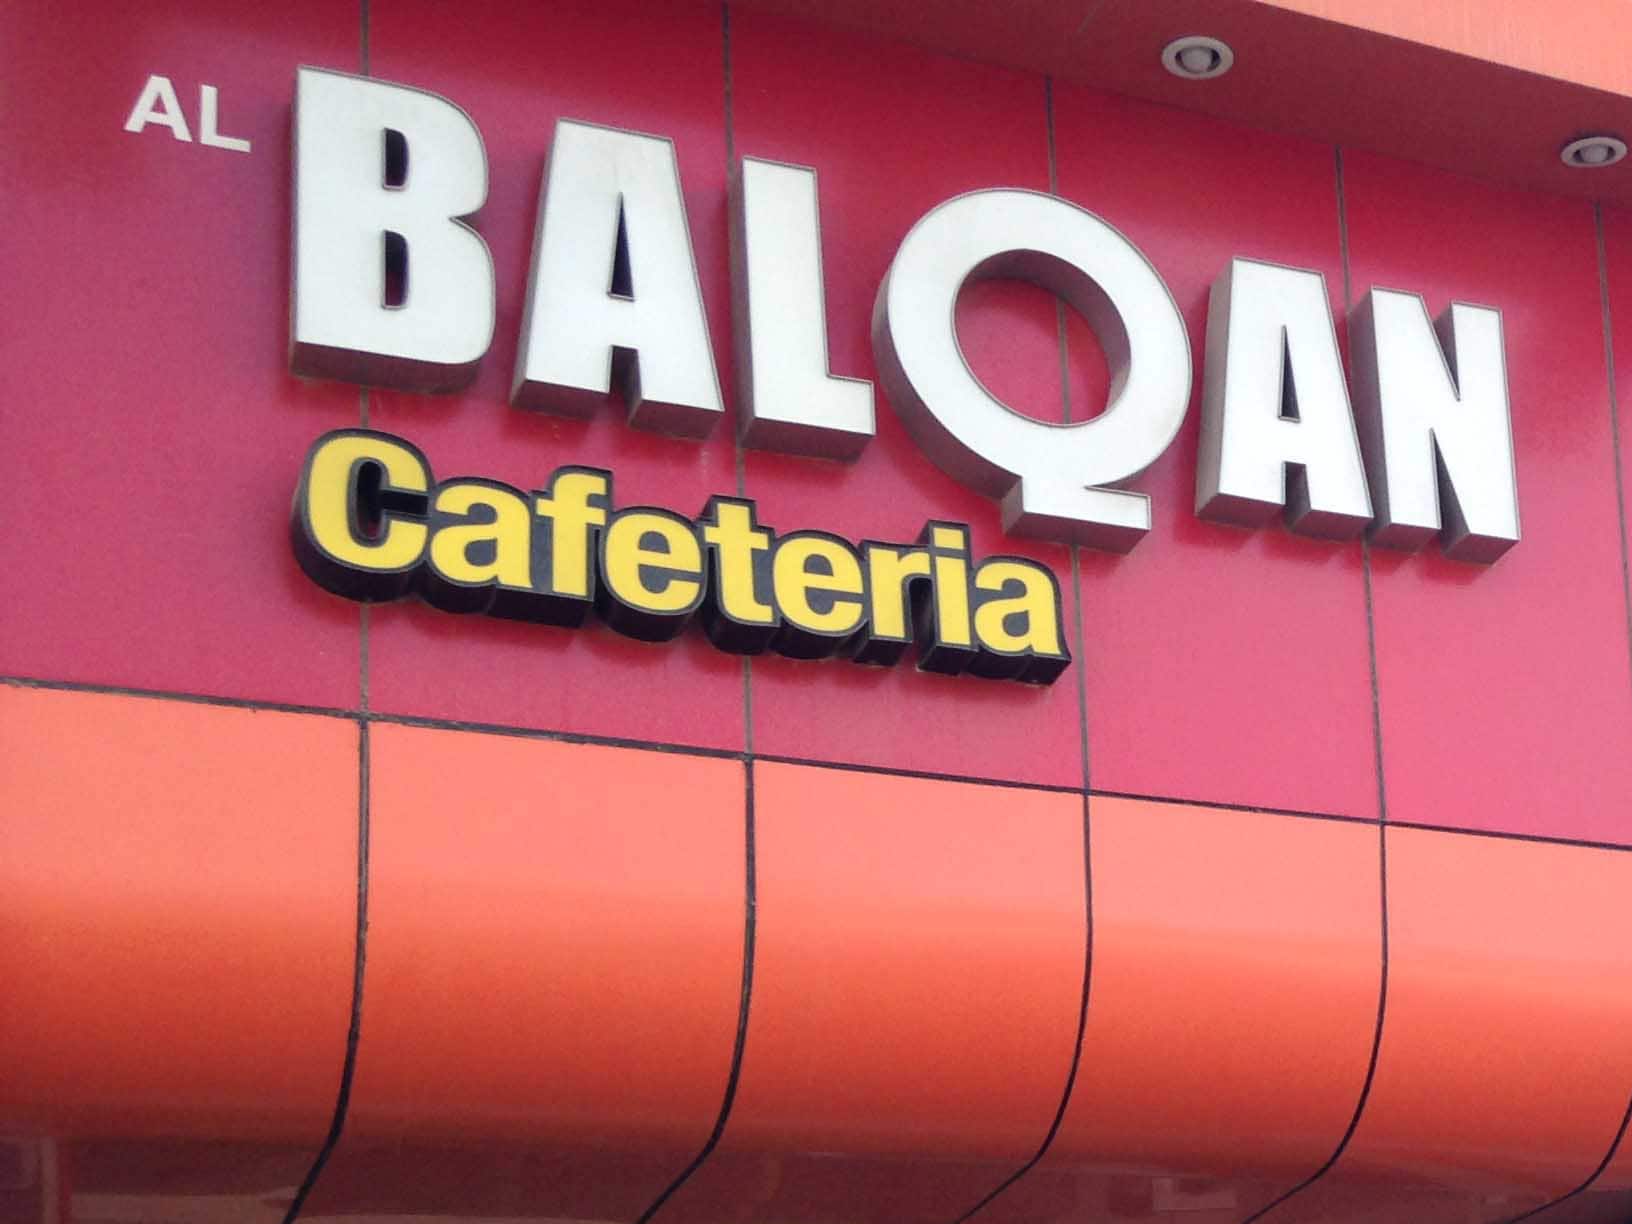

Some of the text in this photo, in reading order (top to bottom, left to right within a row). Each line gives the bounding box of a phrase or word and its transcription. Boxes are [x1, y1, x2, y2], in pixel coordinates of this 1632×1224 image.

[124, 66, 1521, 546] AL BALQAN
[300, 430, 1066, 664] Cafeteria
